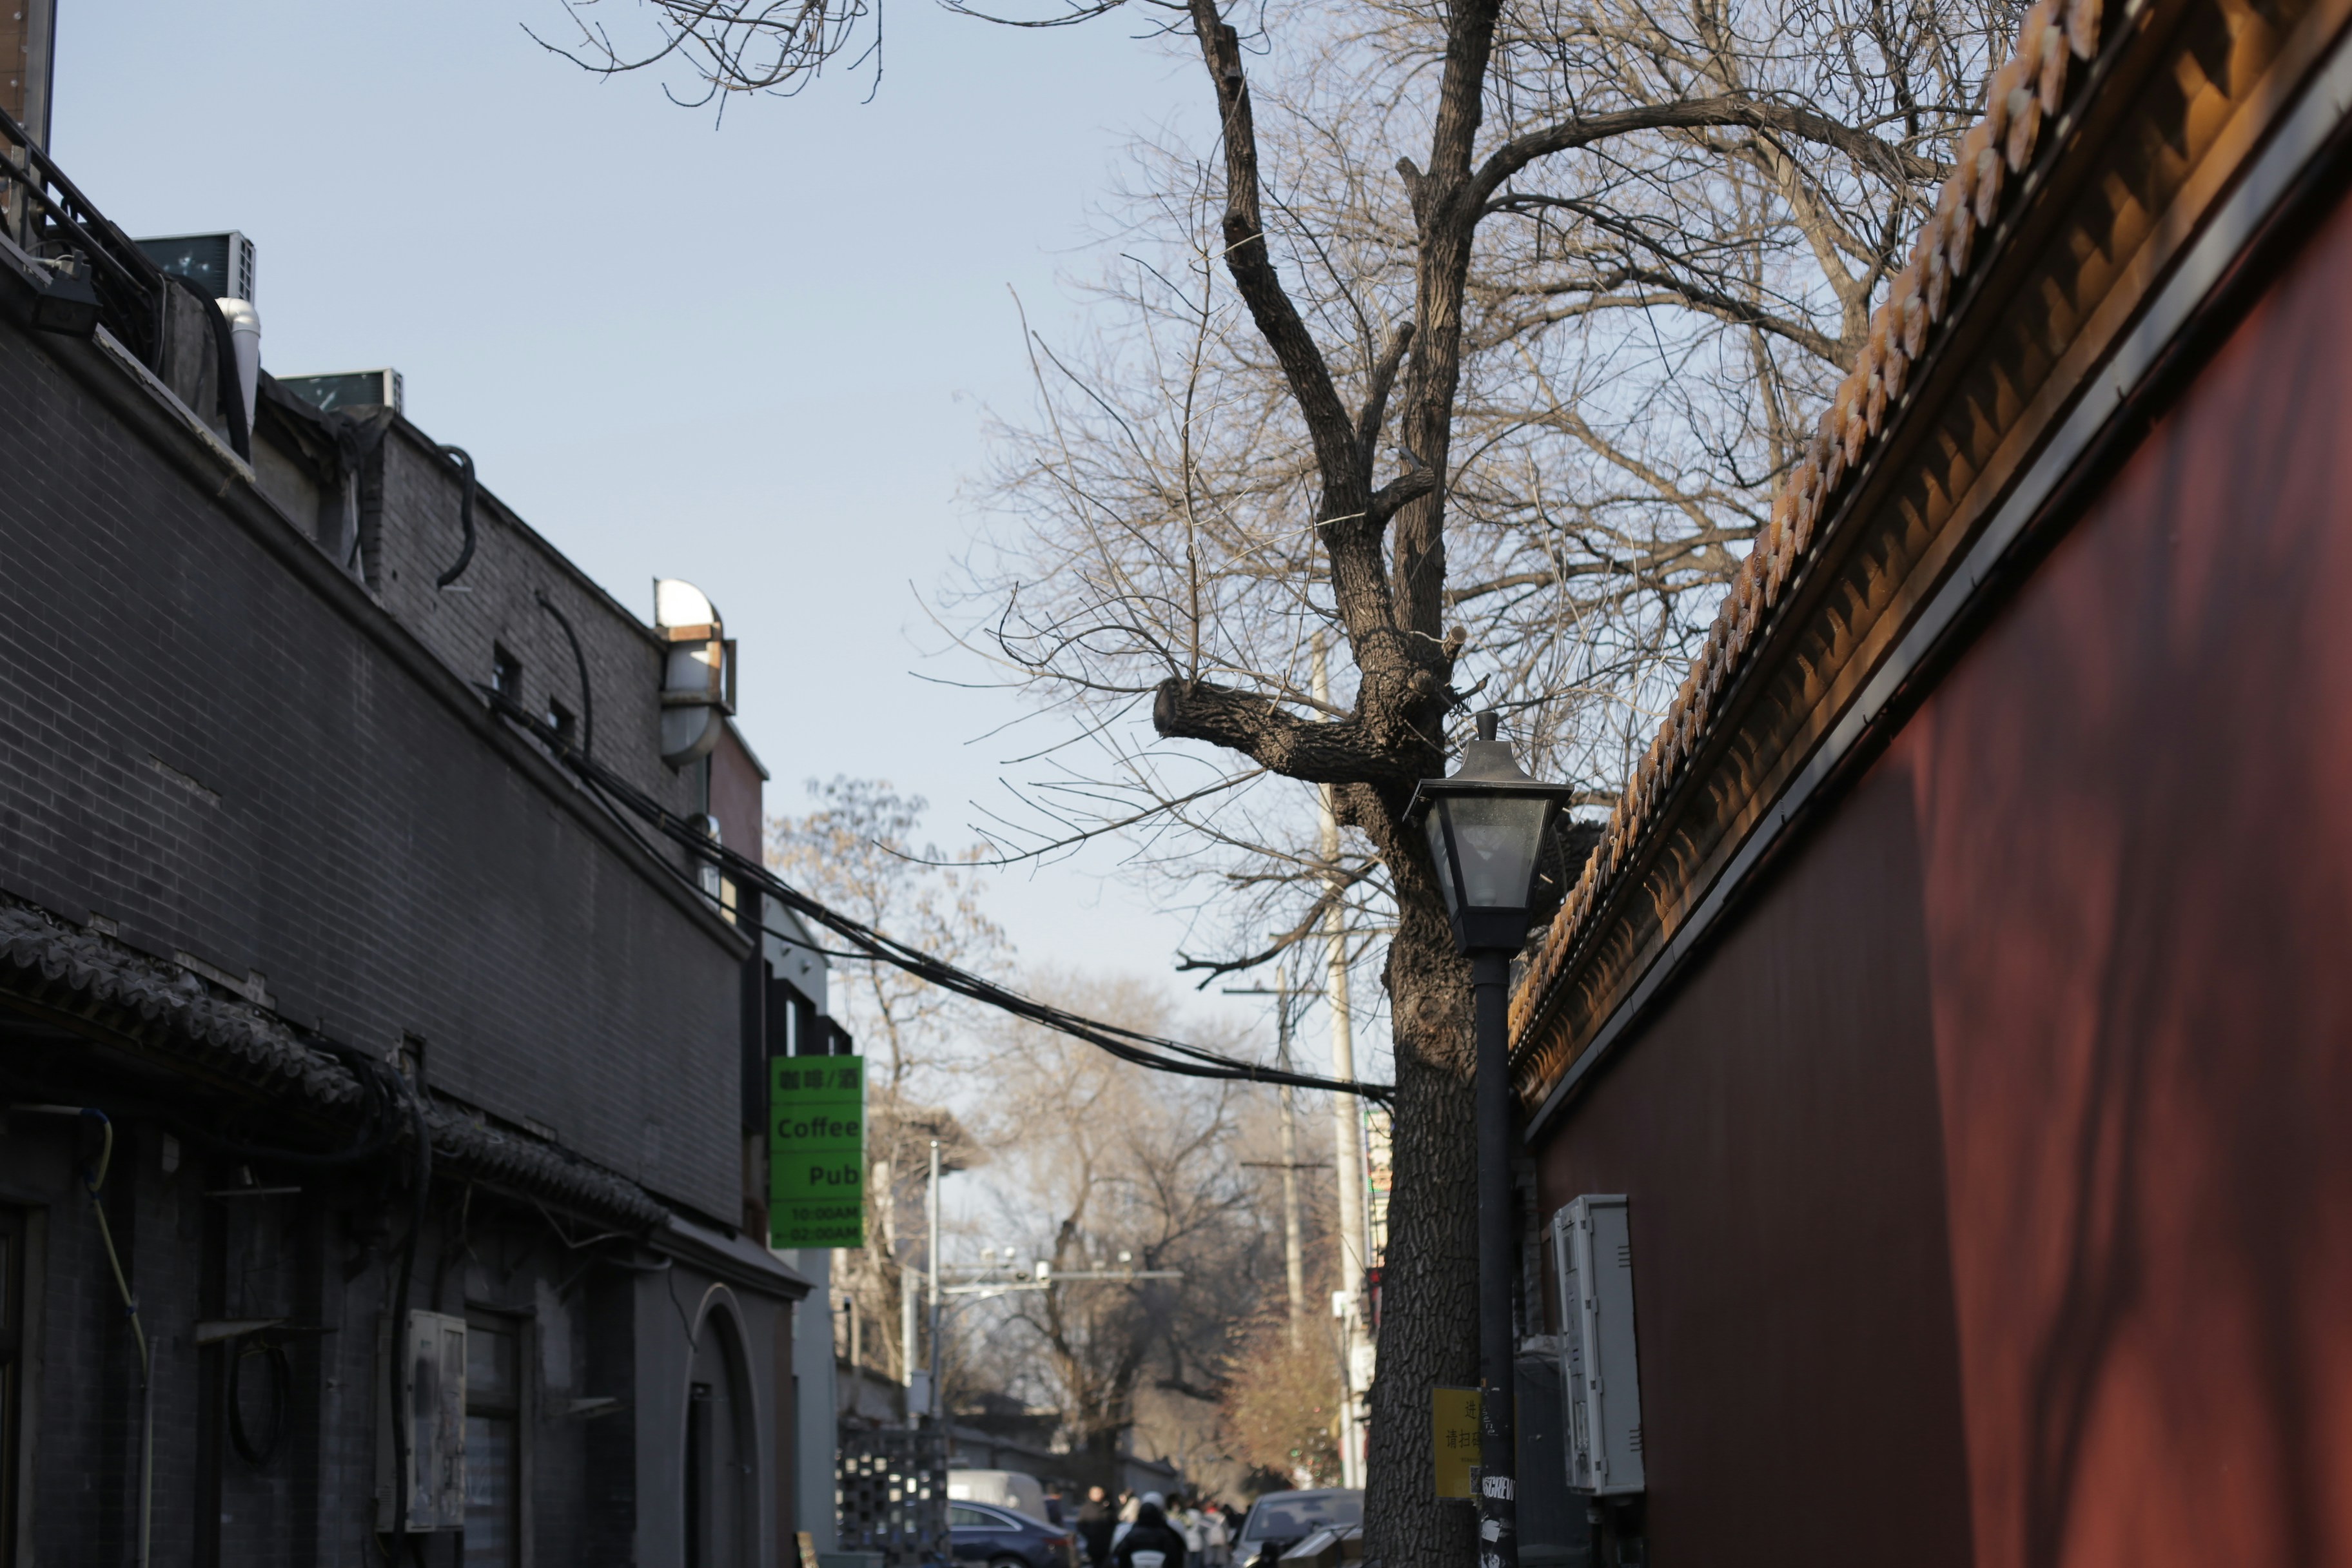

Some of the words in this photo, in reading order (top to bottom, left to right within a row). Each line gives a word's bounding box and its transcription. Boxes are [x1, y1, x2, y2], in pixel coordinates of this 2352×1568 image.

[779, 1068, 859, 1090] 咖啡/酒
[778, 1117, 859, 1139] Coffee
[810, 1164, 859, 1186] Pub
[792, 1206, 858, 1221] 10:00AM
